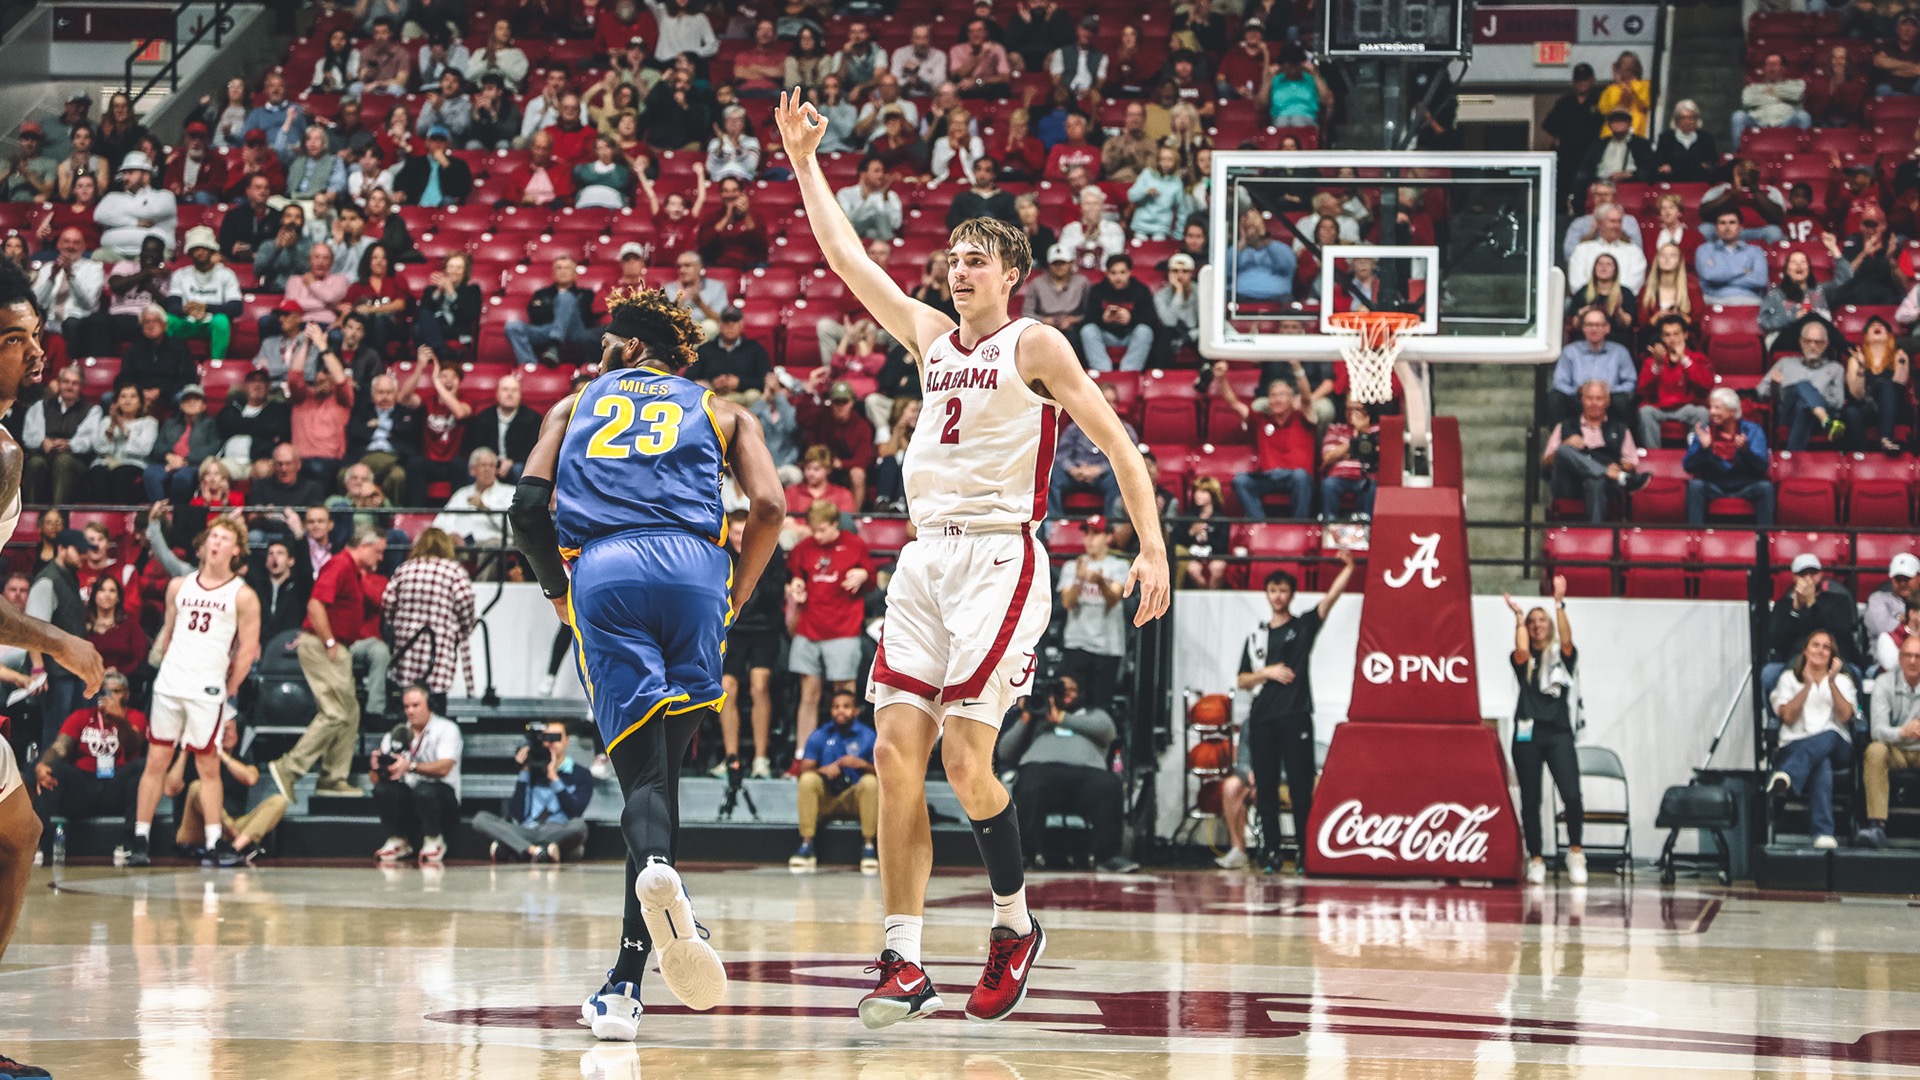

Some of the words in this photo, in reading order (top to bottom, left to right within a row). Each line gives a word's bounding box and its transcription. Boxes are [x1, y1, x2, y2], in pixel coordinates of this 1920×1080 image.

[1482, 14, 1497, 37] J
[1591, 15, 1609, 36] K
[982, 345, 999, 361] SEC
[618, 379, 670, 396] MILES
[926, 367, 998, 393] ALABAMA
[586, 394, 684, 459] 23
[940, 397, 962, 445] 2
[1383, 533, 1442, 589] A
[188, 610, 212, 633] 33
[1398, 654, 1469, 684] PNC
[1317, 799, 1501, 863] Coca-Cola
